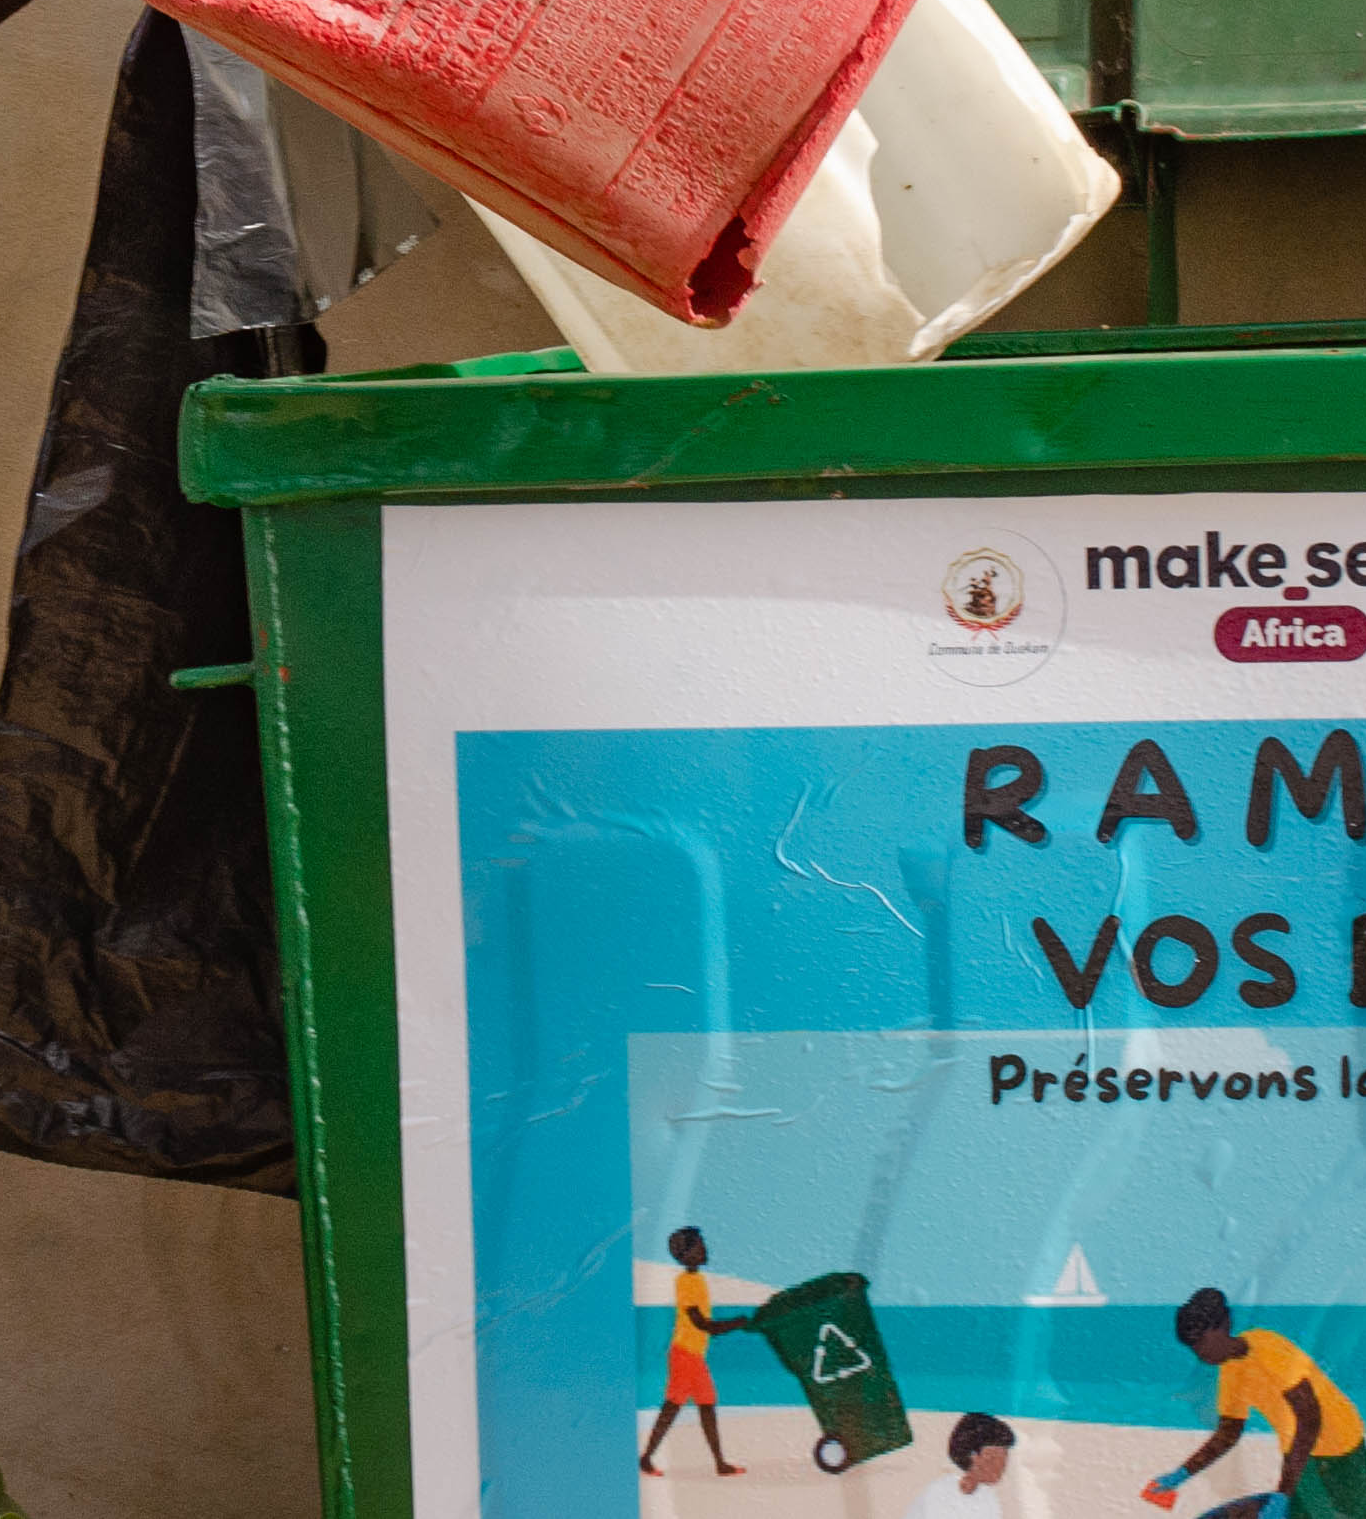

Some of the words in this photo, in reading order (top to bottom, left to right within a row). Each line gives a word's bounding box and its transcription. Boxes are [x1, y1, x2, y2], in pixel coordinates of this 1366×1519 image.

[1243, 617, 1348, 649] Africa
[1033, 912, 1298, 1011] VOS
[990, 1053, 1320, 1106] Préservons
